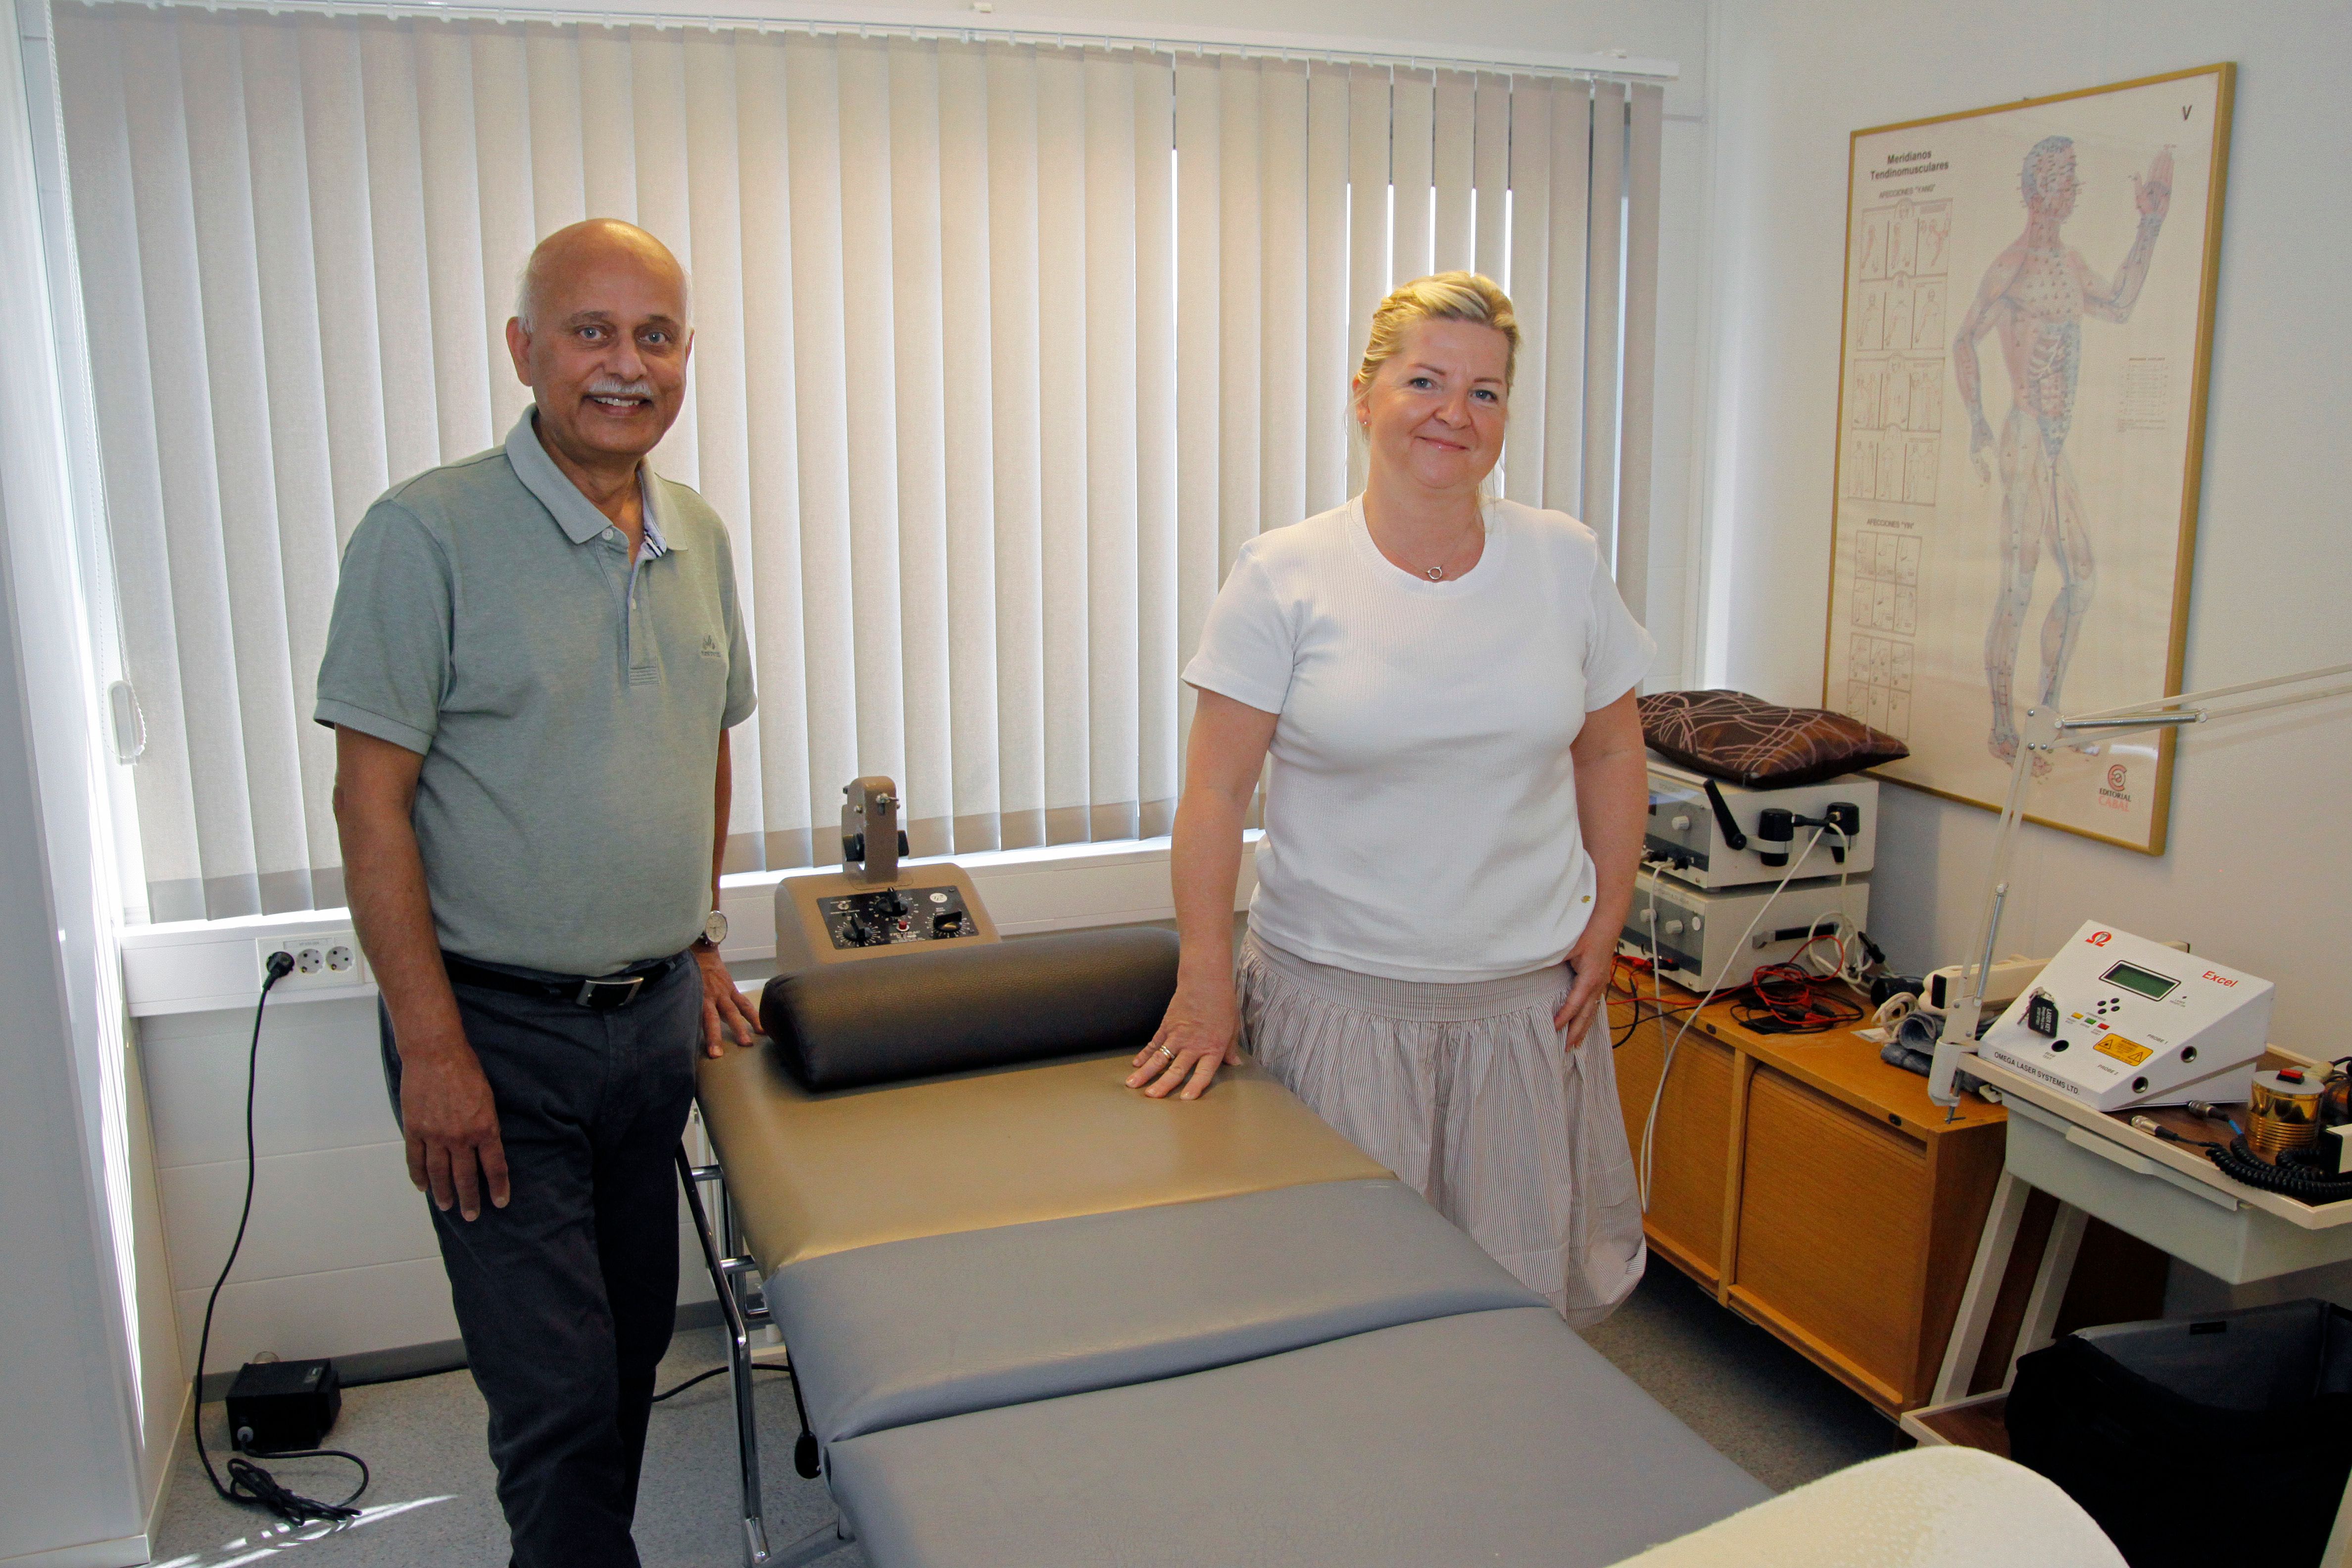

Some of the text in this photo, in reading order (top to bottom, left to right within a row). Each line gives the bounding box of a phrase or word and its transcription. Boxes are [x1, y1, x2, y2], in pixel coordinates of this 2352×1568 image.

[2182, 105, 2192, 120] V
[1888, 150, 1931, 164] Meridianos
[1870, 162, 1949, 180] Tendinomusculares
[2099, 787, 2131, 802] EDITORIAL
[2202, 970, 2239, 987] Excel
[2147, 1033, 2164, 1043] PROBE
[1994, 1051, 2015, 1065] OMEGA
[2016, 1061, 2036, 1075] LASER
[2037, 1071, 2065, 1088] SYSTEMS
[2097, 1064, 2115, 1074] PROBE
